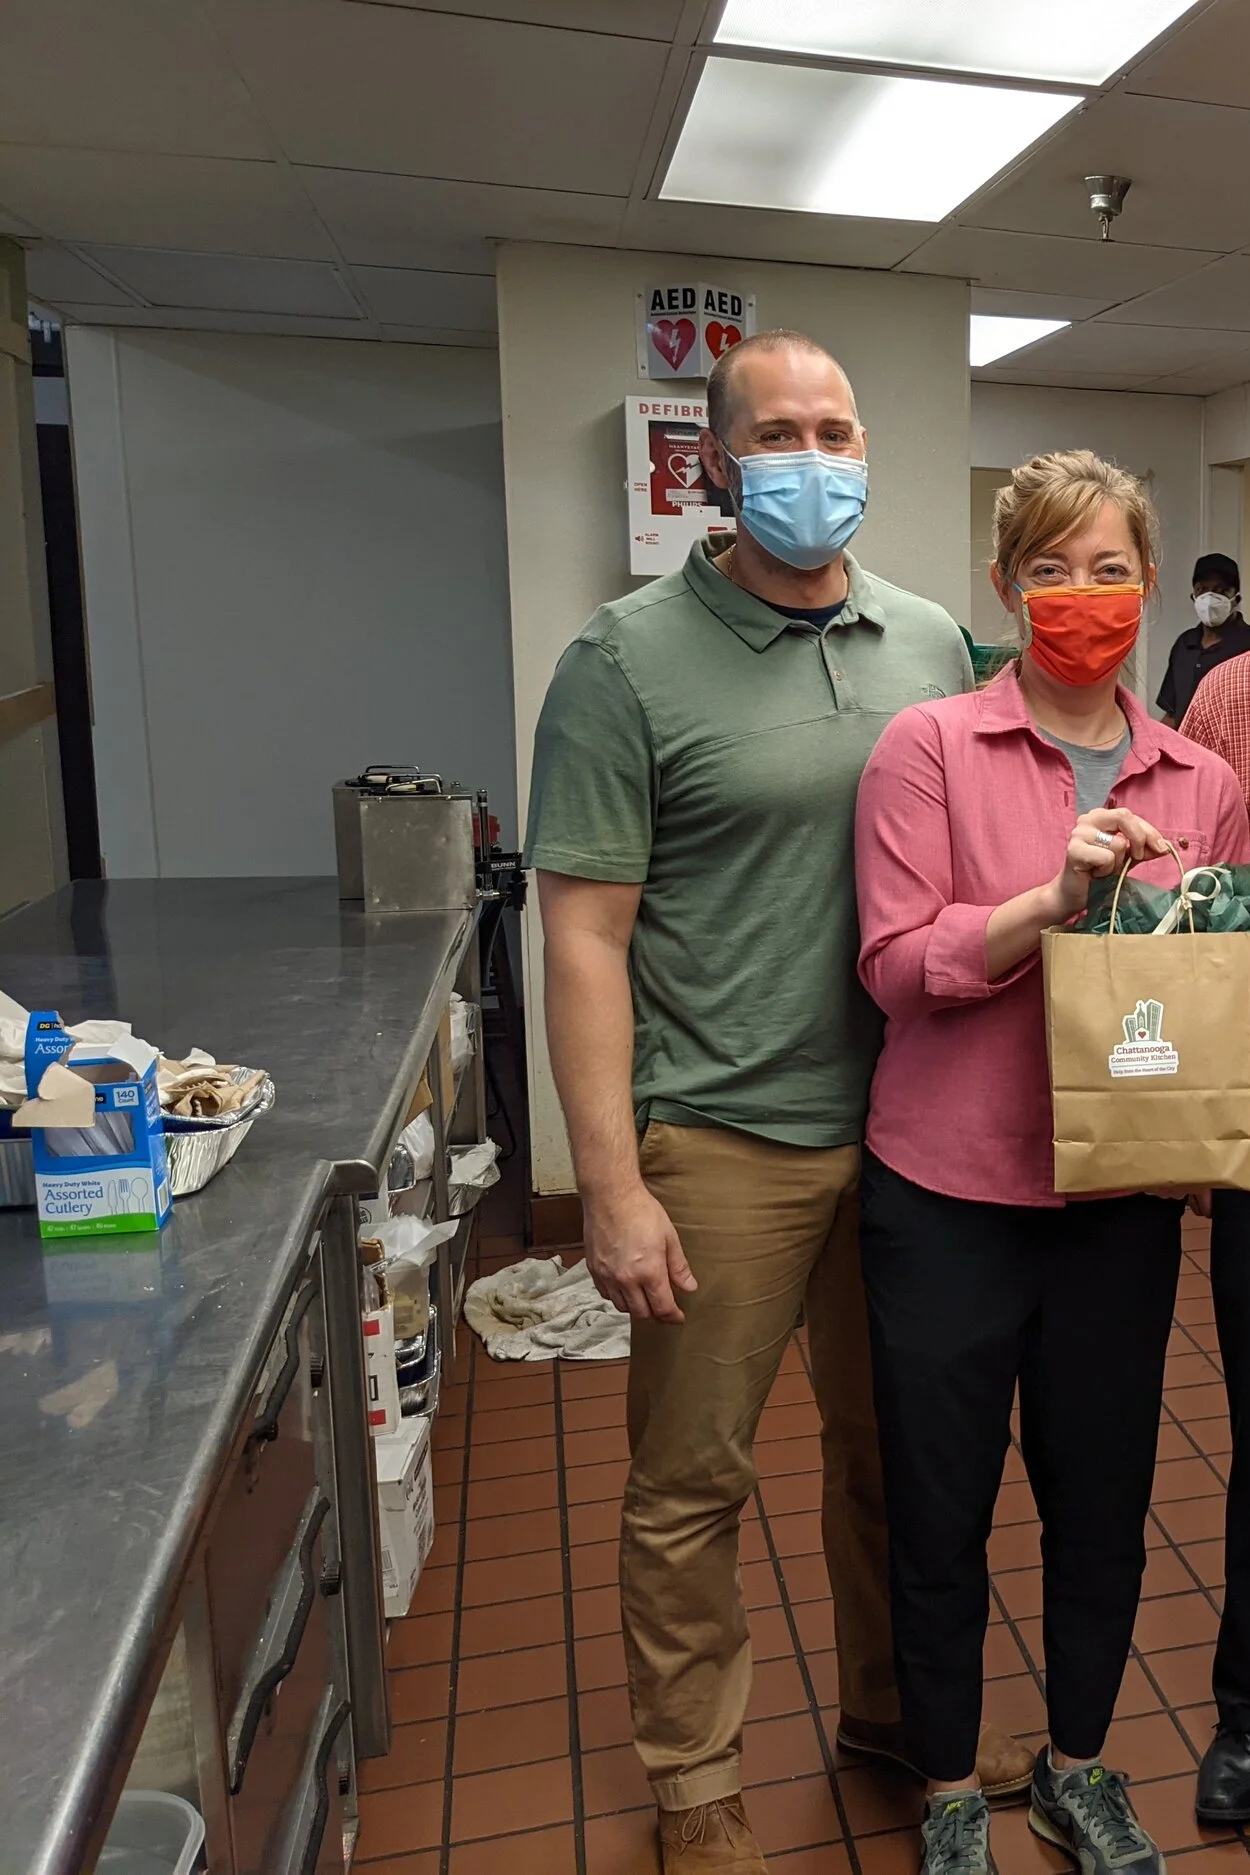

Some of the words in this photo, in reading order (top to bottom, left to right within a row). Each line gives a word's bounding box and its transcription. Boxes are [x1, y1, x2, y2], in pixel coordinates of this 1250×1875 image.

[651, 288, 696, 311] AED
[704, 289, 742, 316] AED
[491, 861, 516, 869] BUNN
[1116, 1046, 1170, 1054] Chattanooga
[116, 1090, 135, 1099] 140
[44, 1186, 104, 1201] Assorted
[45, 1201, 93, 1216] Cutlery
